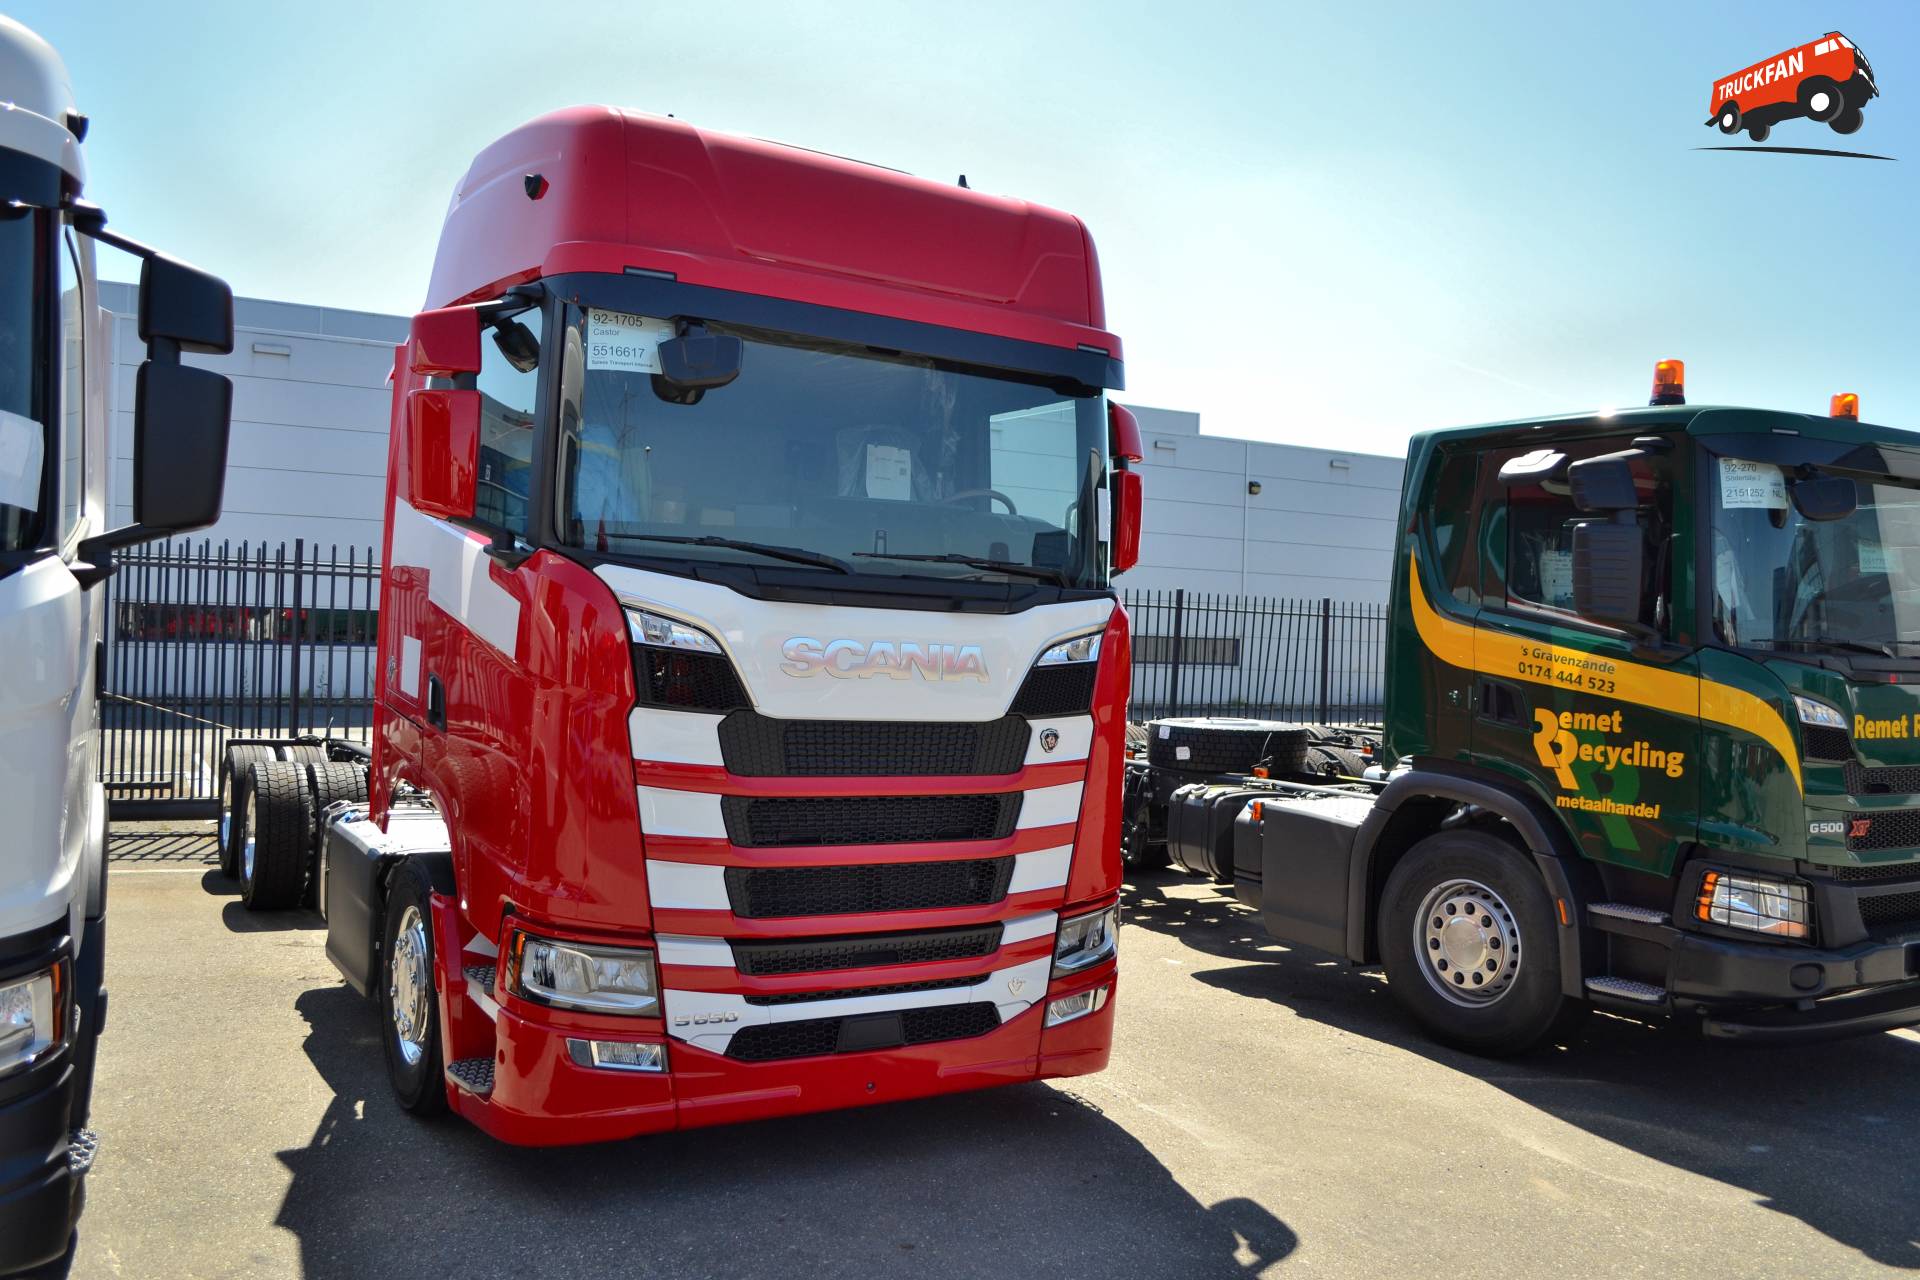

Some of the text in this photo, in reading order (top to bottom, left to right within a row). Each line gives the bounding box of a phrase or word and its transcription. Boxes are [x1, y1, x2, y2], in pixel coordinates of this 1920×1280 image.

[593, 313, 643, 328] 92-1705
[593, 327, 620, 336] Castor
[592, 345, 646, 359] 5516617
[1724, 463, 1757, 473] 92-270
[779, 636, 991, 684] SCANIA
[1532, 648, 1616, 675] Gravenzande
[1518, 661, 1616, 694] 0174 444 523
[1854, 714, 1909, 739] Remet
[1556, 795, 1660, 819] metaalhandel
[1809, 822, 1844, 834] G500
